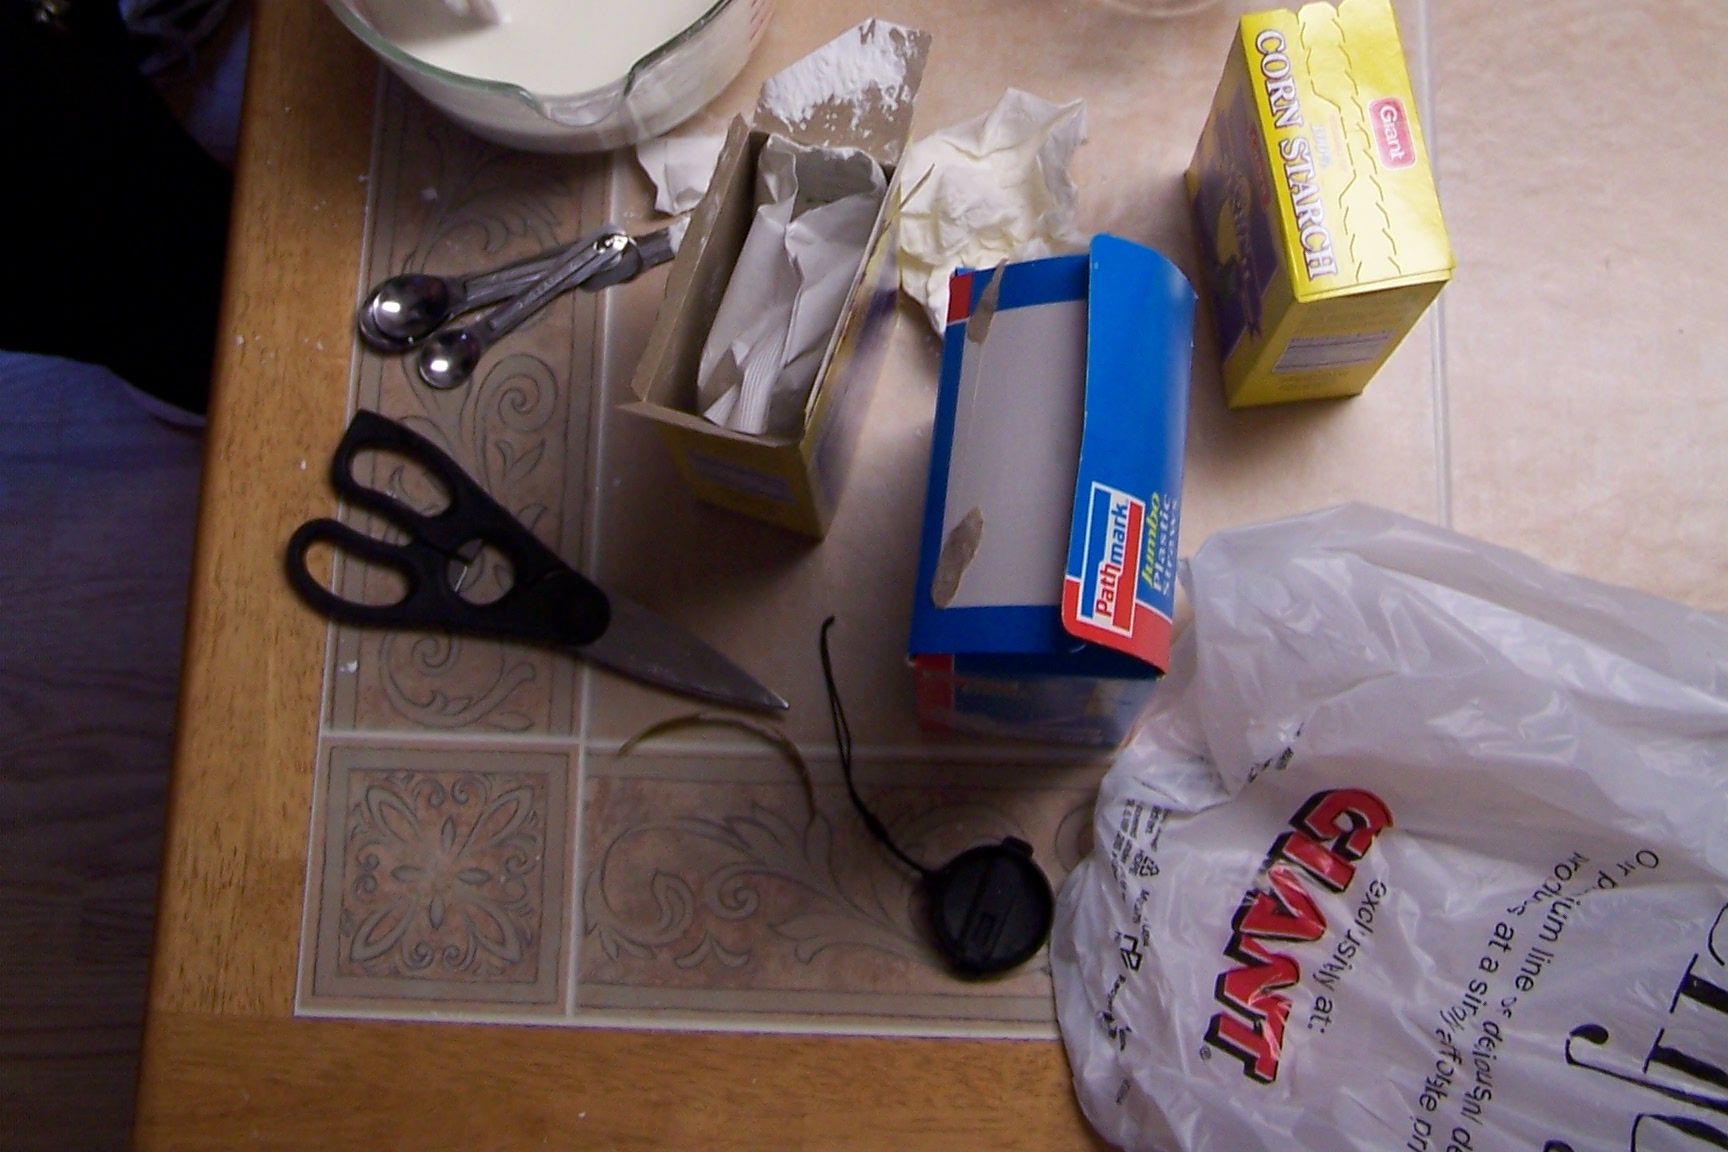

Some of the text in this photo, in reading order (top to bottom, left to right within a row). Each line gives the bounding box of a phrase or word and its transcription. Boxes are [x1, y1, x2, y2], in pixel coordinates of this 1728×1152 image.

[1256, 28, 1304, 130] CORN
[1379, 105, 1406, 161] Giant
[1279, 137, 1338, 282] STARCH
[1095, 501, 1129, 617] Pathmark
[1142, 492, 1161, 588] Jumbo
[1153, 494, 1173, 592] Plastic
[1203, 788, 1395, 1084] GIANT
[1479, 956, 1500, 974] a
[1489, 922, 1515, 953] at
[1515, 948, 1554, 992] line
[1307, 995, 1333, 1034] at:
